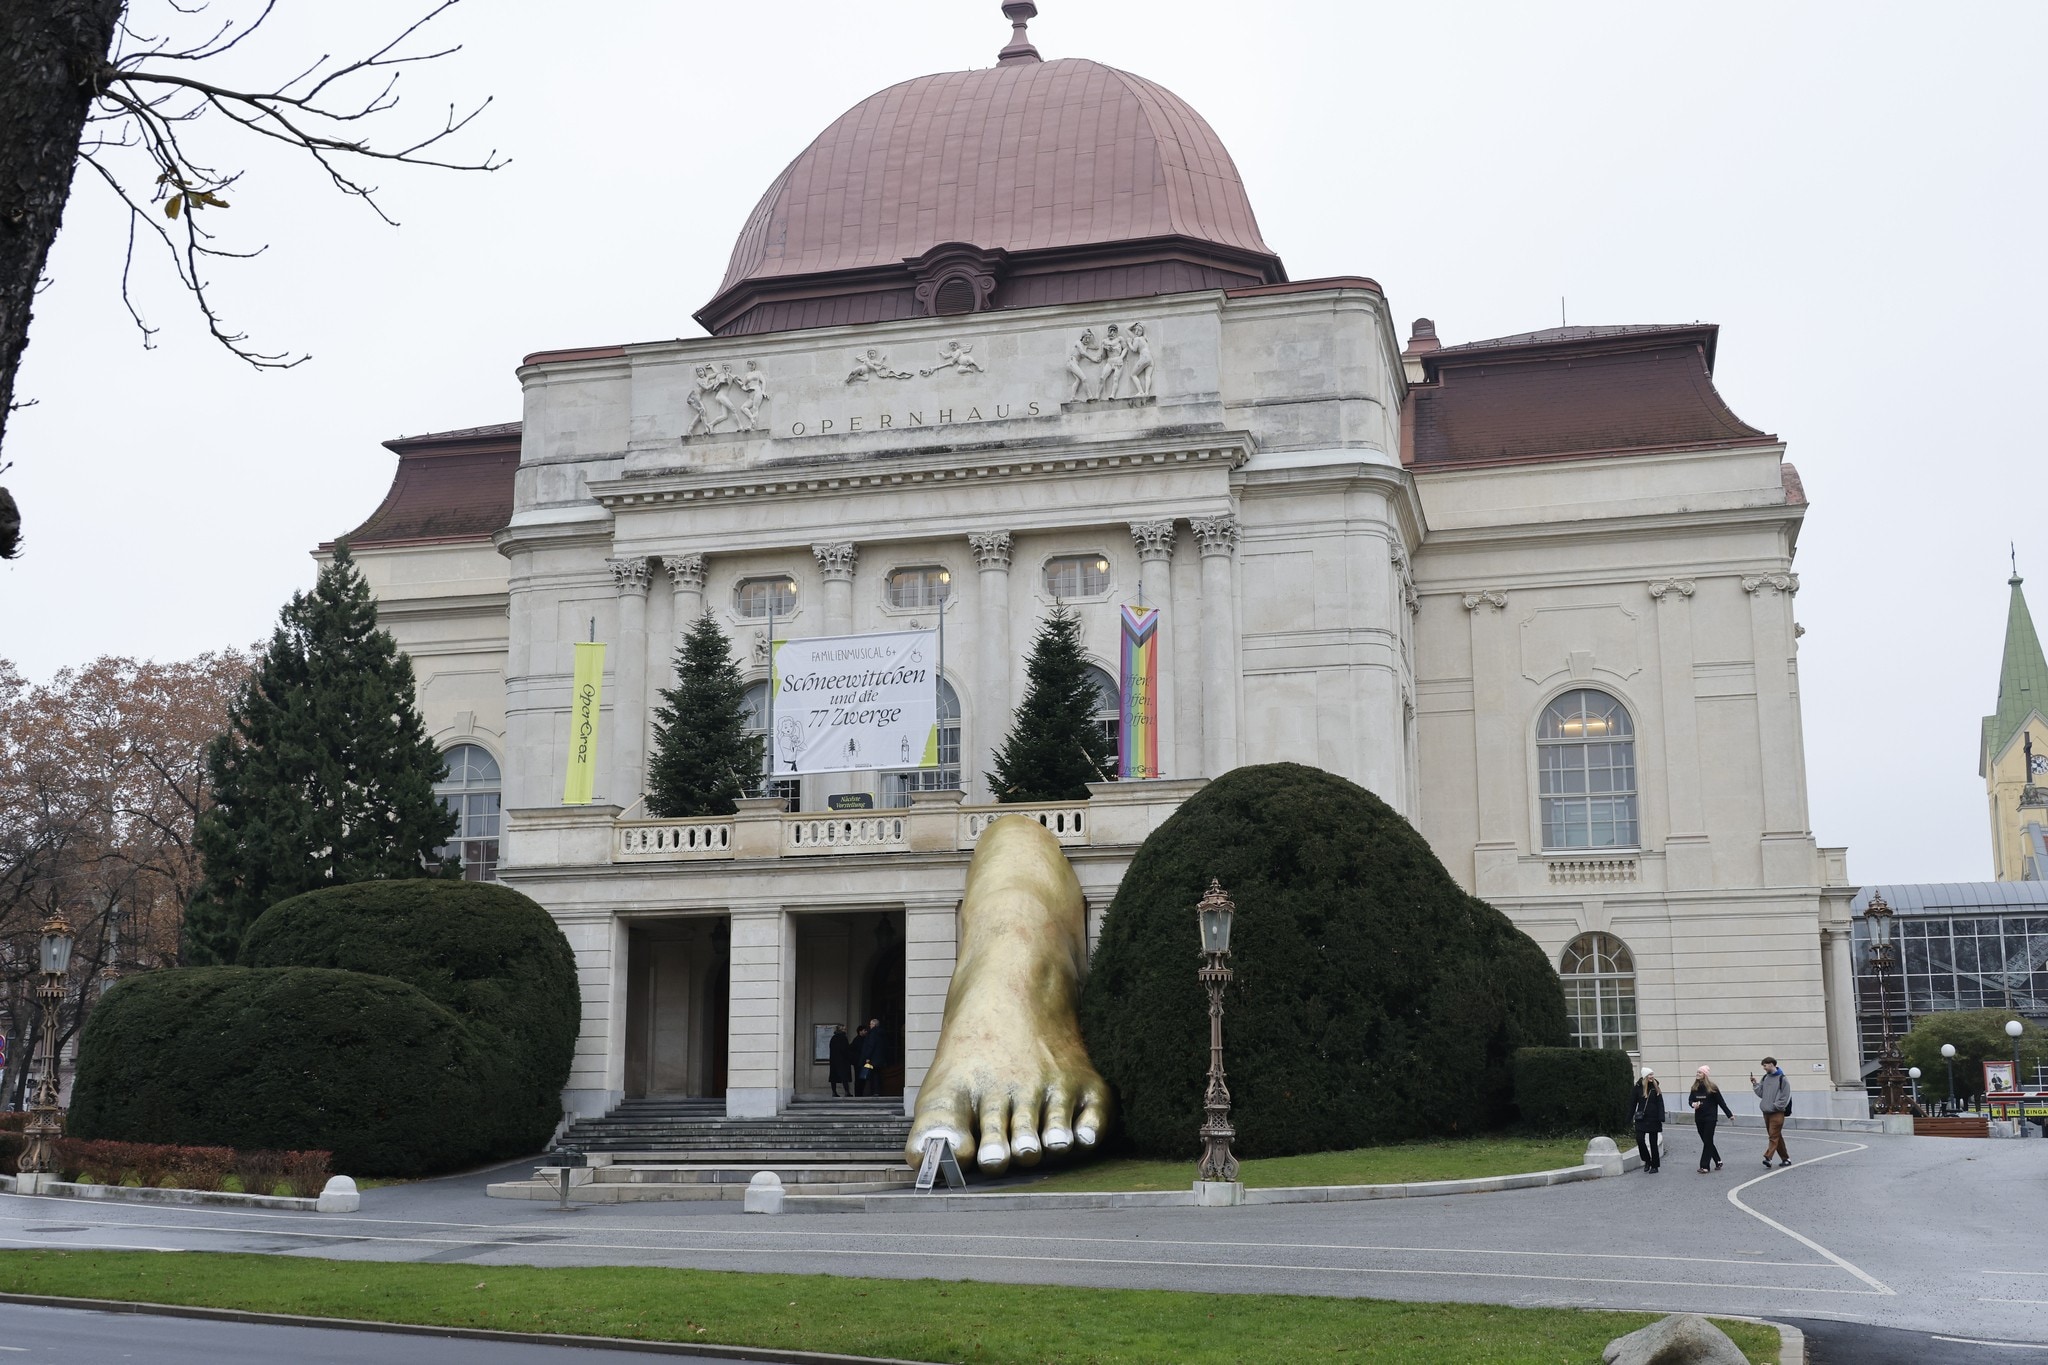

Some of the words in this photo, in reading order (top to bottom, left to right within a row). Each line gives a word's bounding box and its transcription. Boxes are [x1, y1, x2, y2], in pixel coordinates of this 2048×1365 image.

[791, 401, 1040, 436] OPERNHAUS
[811, 646, 884, 662] FAMILIENMUSICAL
[885, 646, 897, 657] 6+
[783, 666, 925, 692] Schneewittchen
[830, 692, 856, 705] und
[858, 689, 879, 704] die
[808, 709, 829, 728] 77
[831, 707, 902, 728] Zwerge
